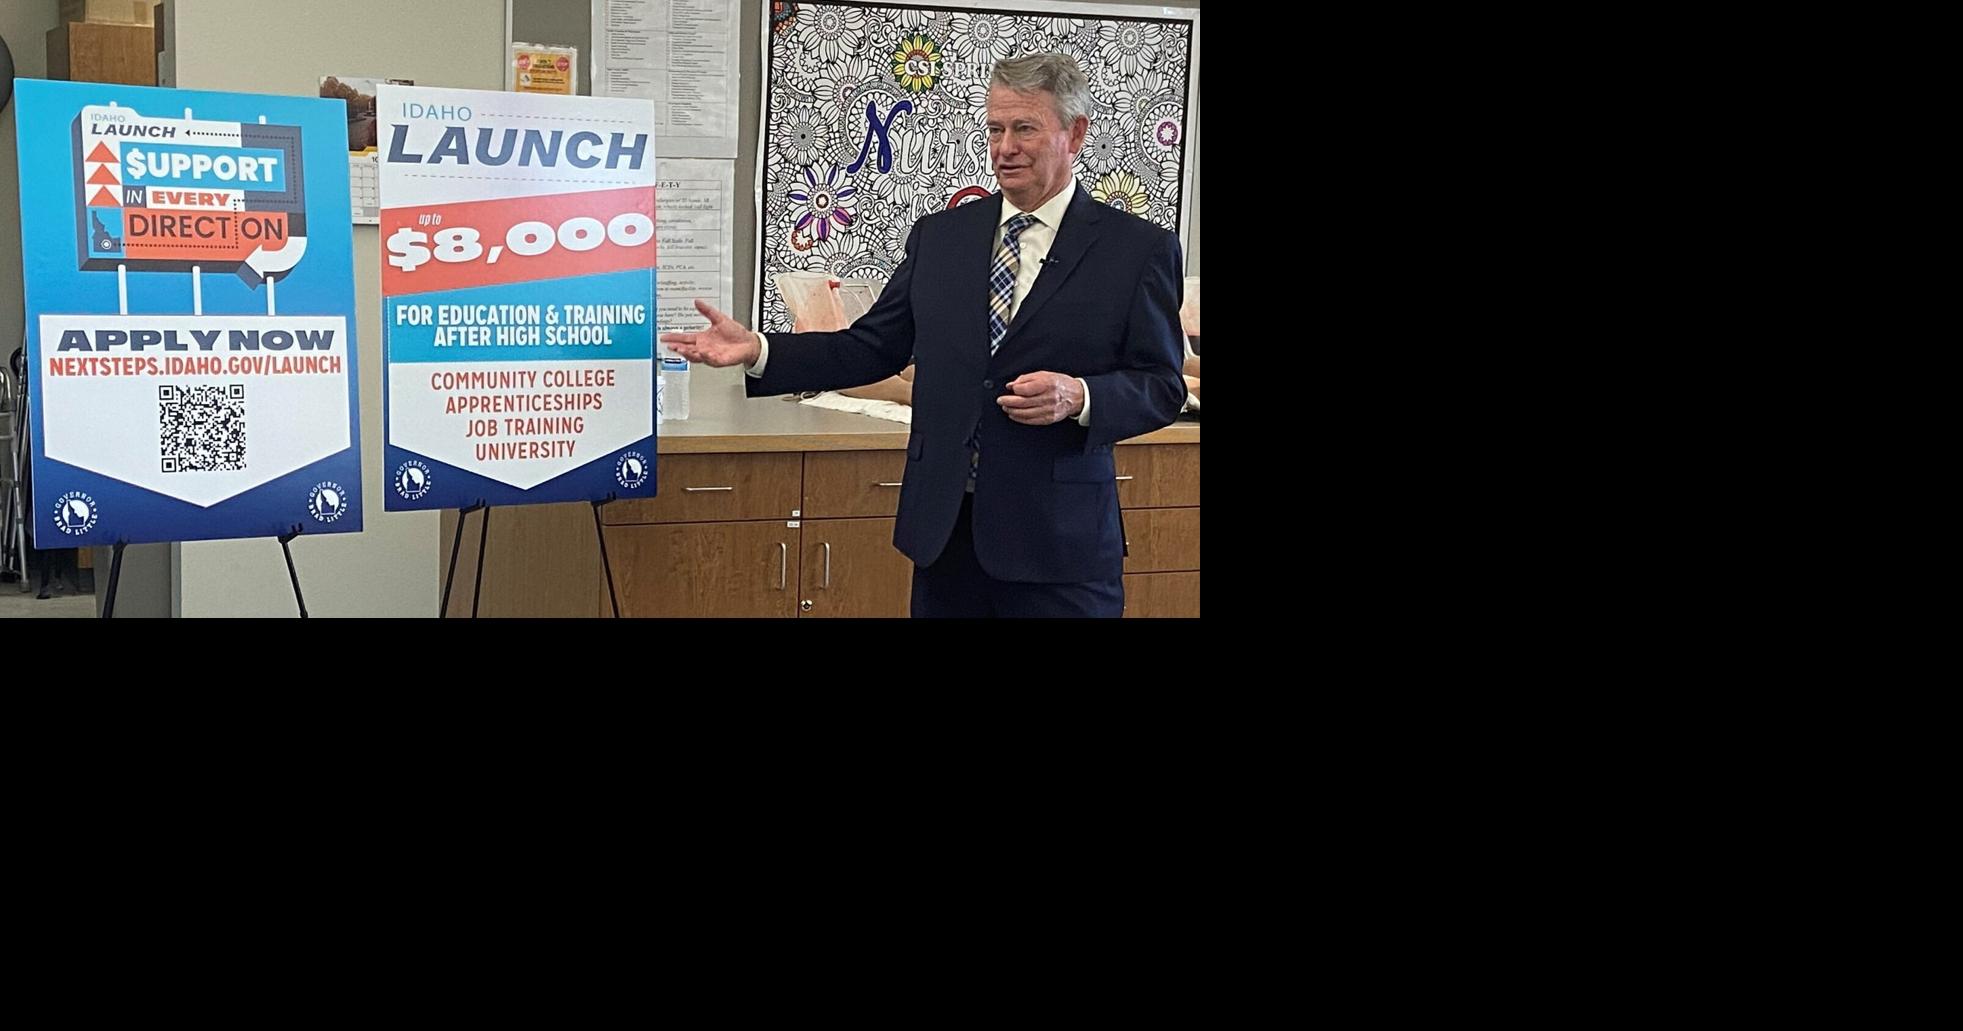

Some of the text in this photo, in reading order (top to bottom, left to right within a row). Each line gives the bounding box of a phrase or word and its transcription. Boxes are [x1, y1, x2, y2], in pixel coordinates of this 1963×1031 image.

[904, 60, 936, 77] CSI
[90, 113, 126, 123] IDAHO
[402, 102, 472, 121] IDAHO
[91, 123, 176, 138] LAUNCH
[387, 124, 649, 170] LAUNCH
[126, 148, 278, 183] $UPPORT
[126, 190, 231, 207] IN EVERY
[418, 213, 441, 226] up to
[386, 212, 655, 272] $8,000
[396, 304, 645, 326] FOR EDUCATION & TRAINING
[57, 329, 335, 352] APPLY NOW
[434, 325, 612, 347] AFTER HIGH SCHOOL
[50, 355, 341, 377] NEXTSTEPS.IDAHO.GOV/LAUNCH
[431, 369, 615, 390] COMMUNITY COLLEGE
[446, 393, 603, 414] APPRENTICESHIPS
[466, 416, 584, 438] JOB TRAINING
[476, 440, 576, 461] UNIVERSITY
[55, 491, 96, 508] GOVERNOR
[75, 514, 98, 536] LITTLE
